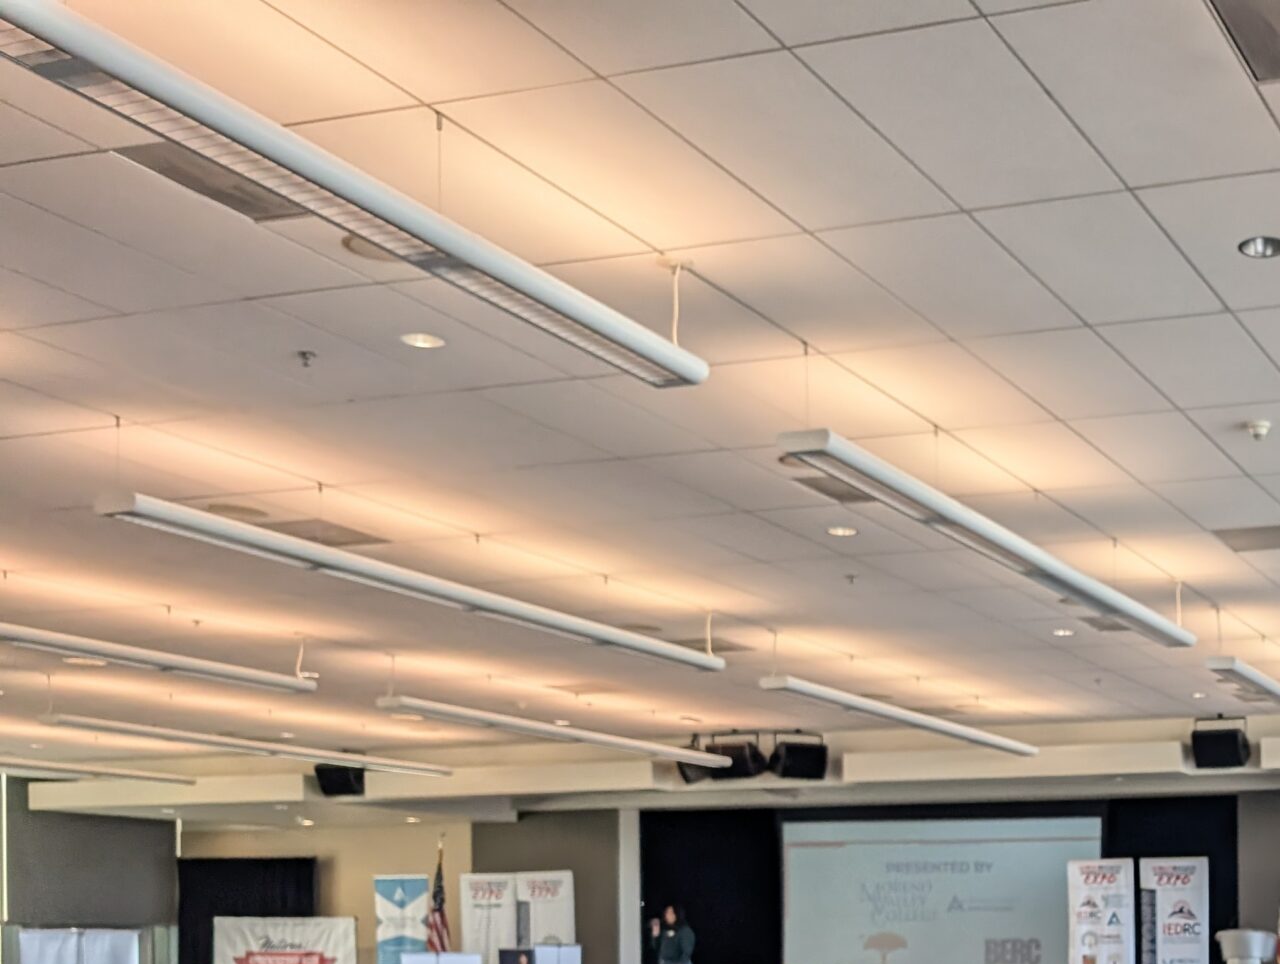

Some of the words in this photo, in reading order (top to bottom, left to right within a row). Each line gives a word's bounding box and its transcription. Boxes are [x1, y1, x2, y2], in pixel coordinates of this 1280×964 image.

[885, 861, 970, 874] PRESENTED
[974, 861, 993, 873] BY
[1162, 922, 1202, 936] IEDRC
